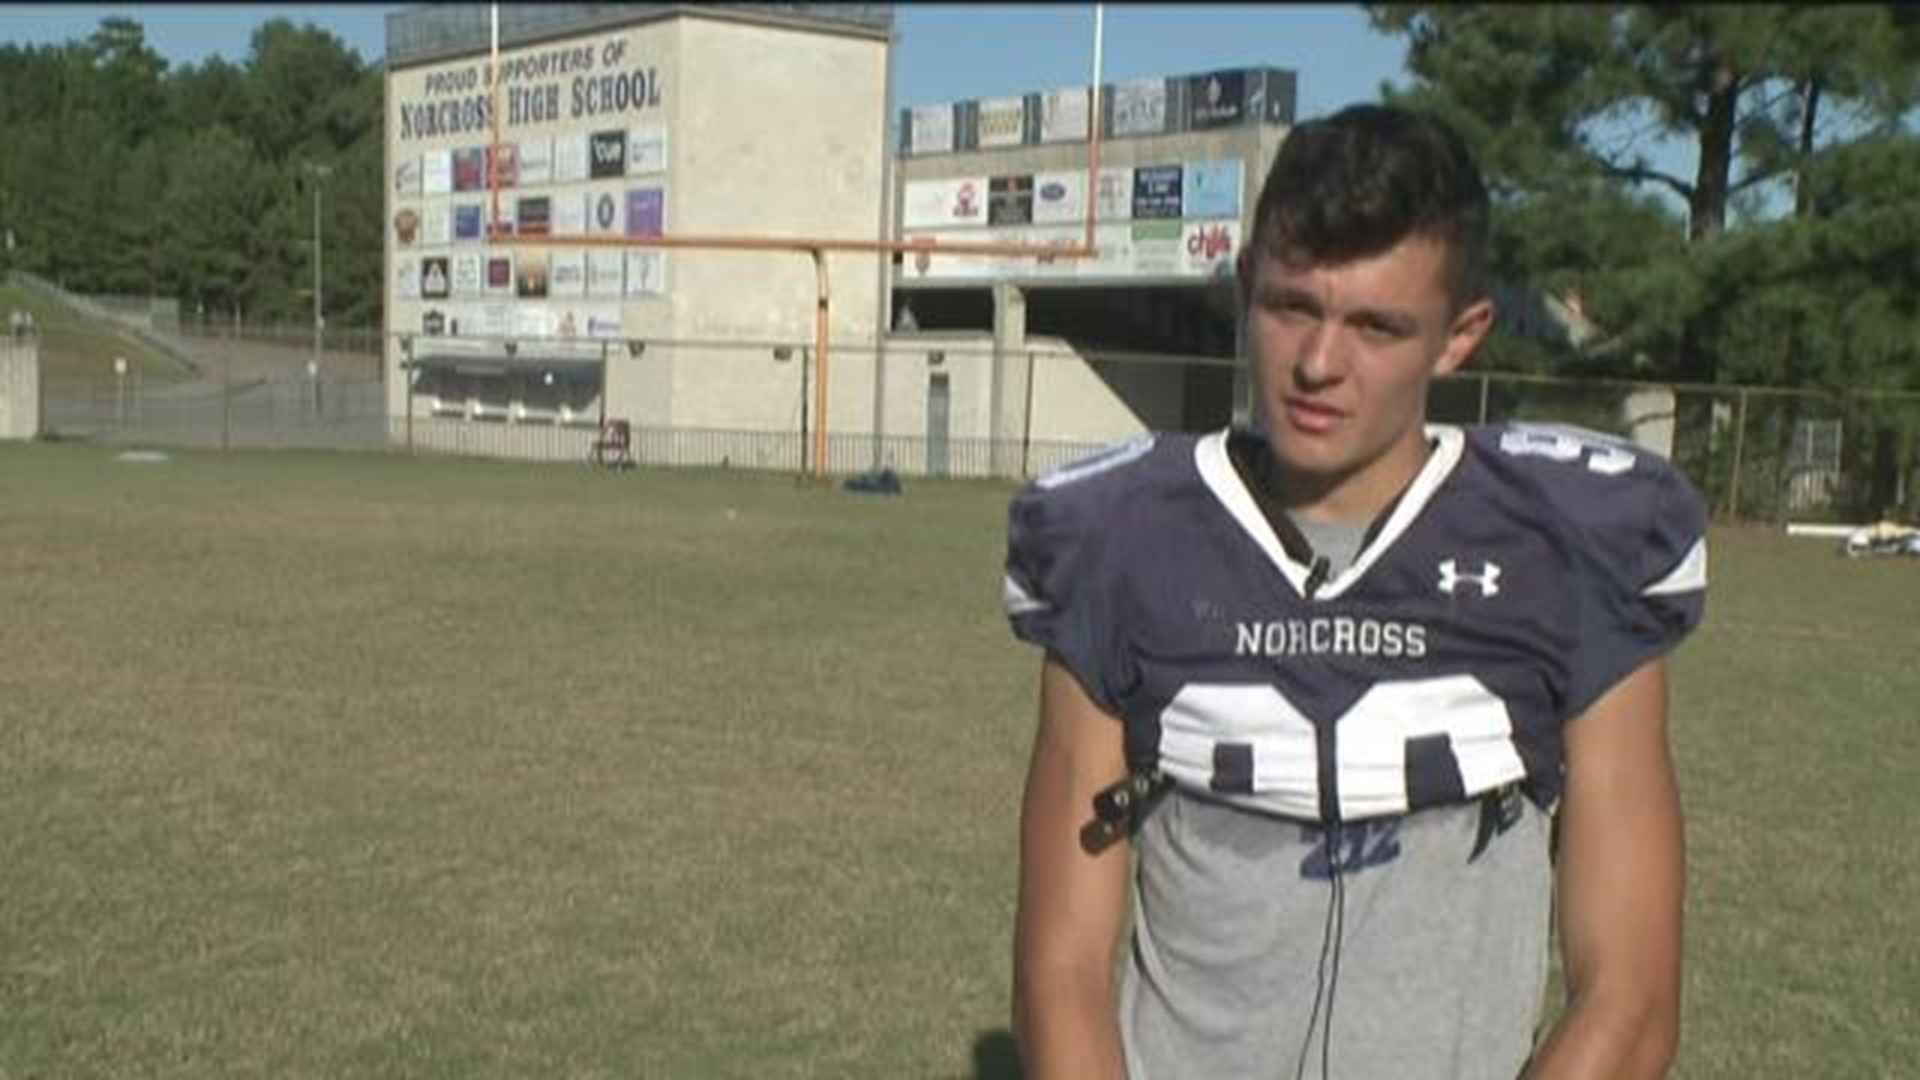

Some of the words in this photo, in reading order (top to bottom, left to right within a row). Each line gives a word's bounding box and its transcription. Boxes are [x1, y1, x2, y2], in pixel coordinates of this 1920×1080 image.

[425, 68, 478, 97] PROUD
[483, 46, 594, 86] SPPORTERS
[602, 40, 628, 69] OF
[508, 83, 560, 127] HIGH
[571, 68, 661, 119] SCHOOL
[1235, 616, 1427, 657] NORCROSS
